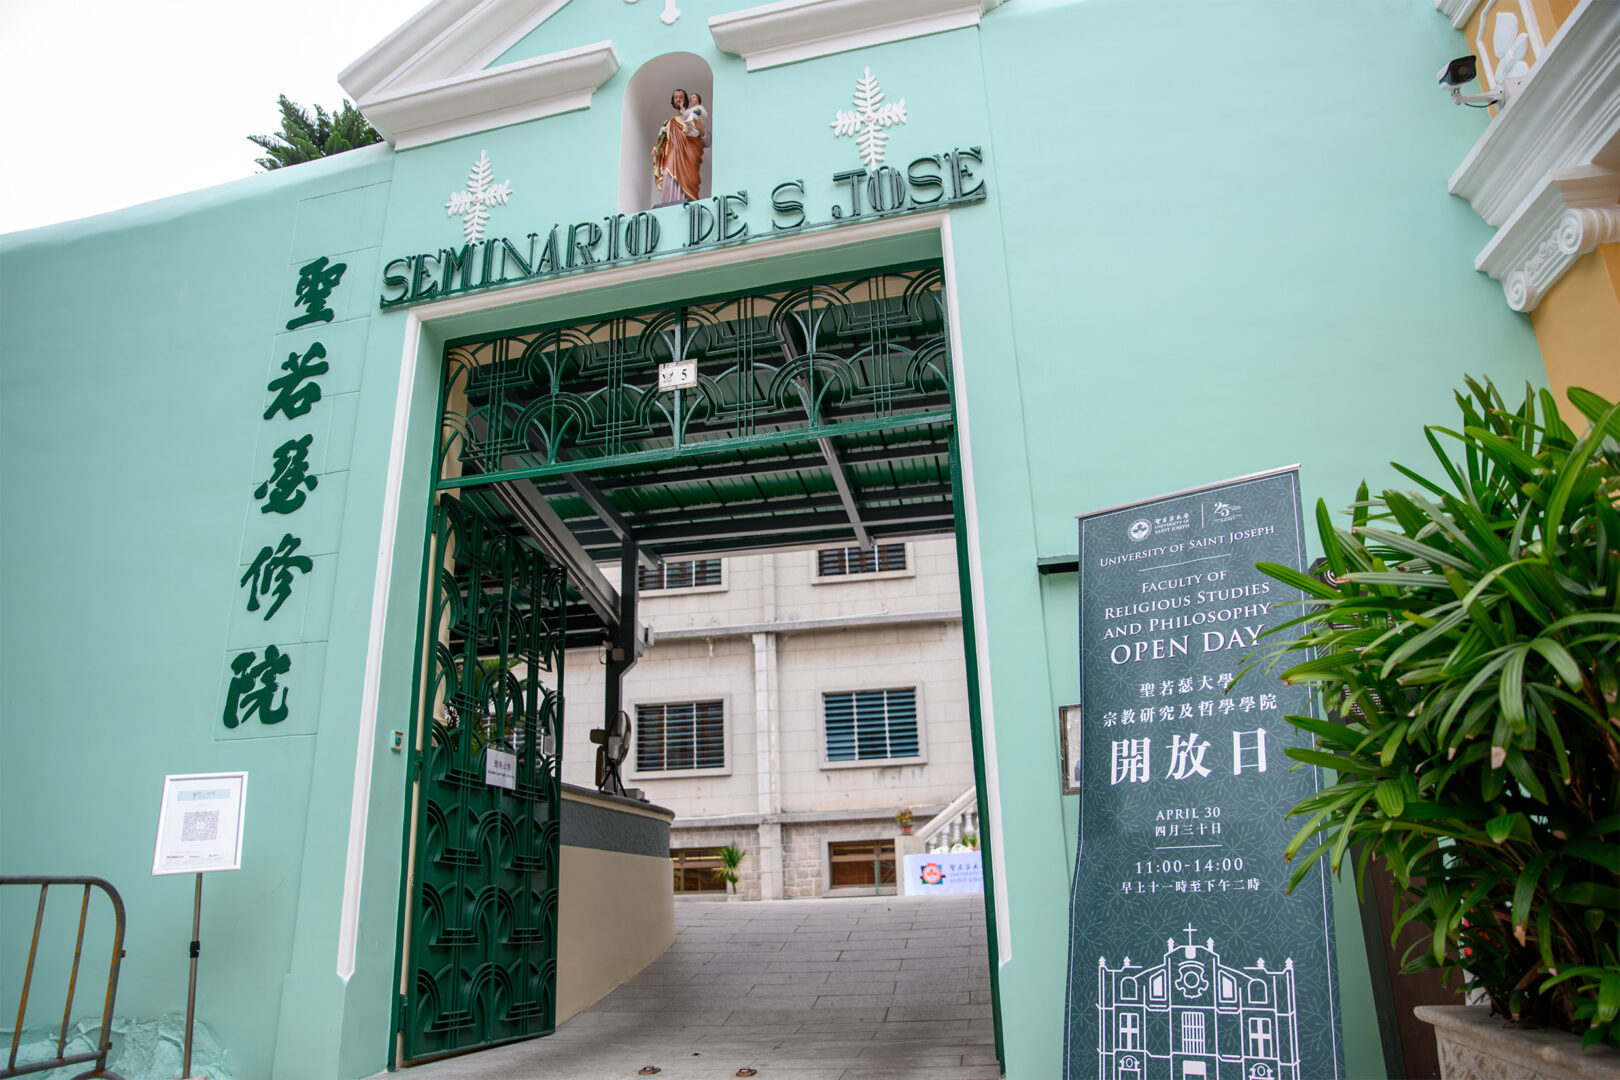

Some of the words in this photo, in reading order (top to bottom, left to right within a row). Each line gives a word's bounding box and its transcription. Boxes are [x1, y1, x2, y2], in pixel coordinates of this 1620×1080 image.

[380, 211, 660, 308] SEMINÁRIO
[683, 189, 748, 248] DE
[681, 368, 687, 380] 5
[223, 256, 347, 729] 聖若瑟修院
[1110, 635, 1190, 665] OPEN
[1202, 624, 1265, 653] DAY
[1139, 673, 1234, 698] 聖若瑟大學
[1103, 693, 1278, 728] 宗教研究及哲學學院
[1110, 727, 1267, 786] 開放日
[1156, 807, 1199, 821] APRIL
[1204, 806, 1221, 818] 30
[1155, 822, 1222, 837] 四月三十日
[1135, 857, 1244, 874] 11:00-14:00
[1122, 878, 1261, 895] 早上十一時至下午二時
